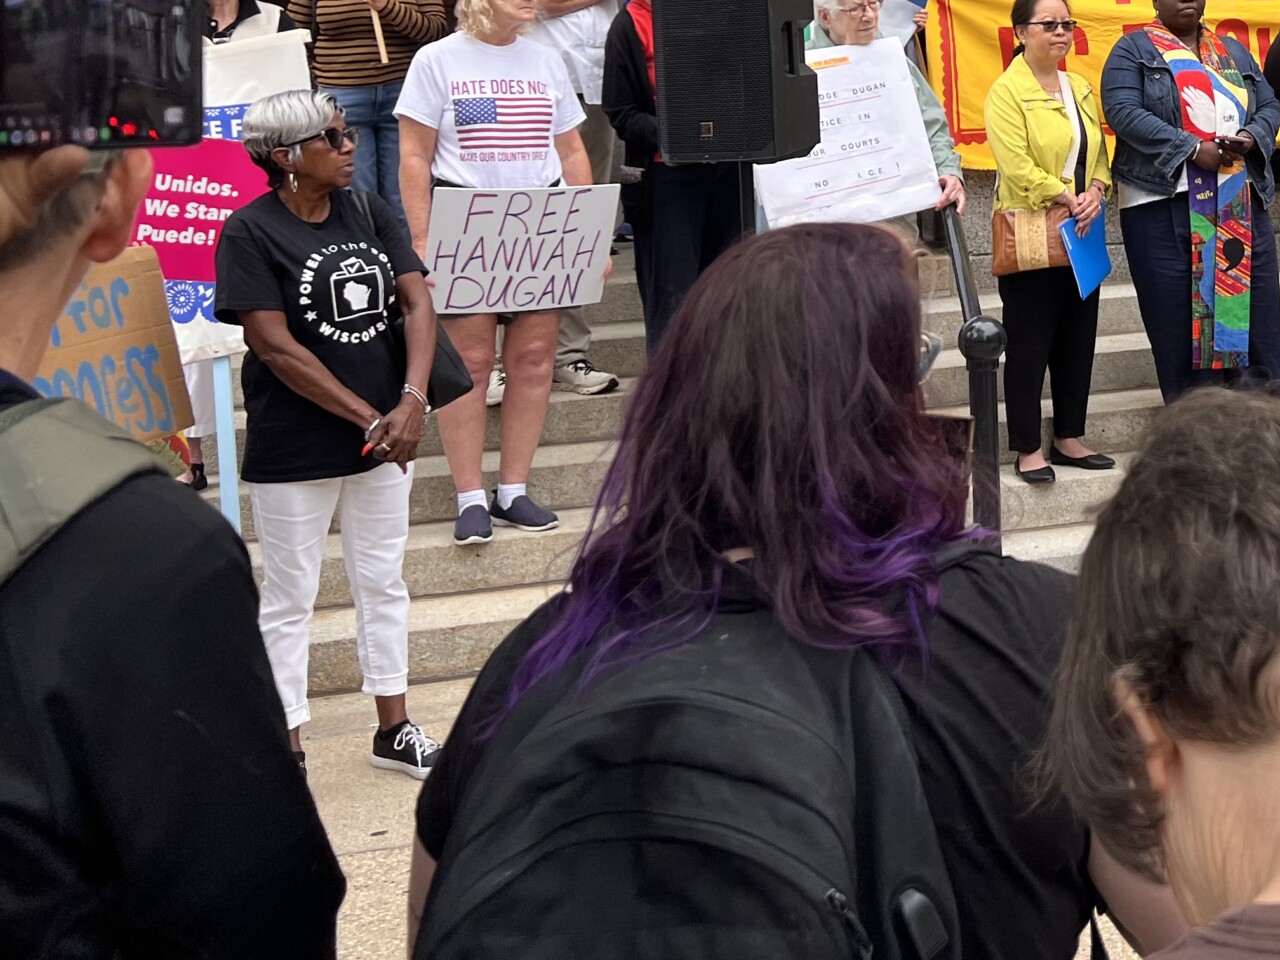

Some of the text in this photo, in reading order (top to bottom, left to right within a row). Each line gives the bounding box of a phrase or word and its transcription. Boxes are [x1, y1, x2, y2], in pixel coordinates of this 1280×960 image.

[451, 80, 487, 96] HATE
[490, 78, 525, 95] DOES
[819, 81, 887, 101] DGE DUGAN
[820, 113, 872, 128] TICE IN
[840, 137, 881, 152] COURTS
[479, 152, 496, 162] OUR
[497, 152, 531, 162] COUNTRY
[154, 173, 240, 198] Unidos.
[814, 179, 830, 189] NO
[144, 198, 234, 222] We Stan
[463, 188, 593, 237] FREE
[136, 223, 217, 246] Puede!
[433, 228, 601, 275] HANNAH
[298, 253, 325, 306] POWER
[321, 244, 339, 255] to
[341, 241, 368, 251] the
[444, 268, 585, 311] DUGAN
